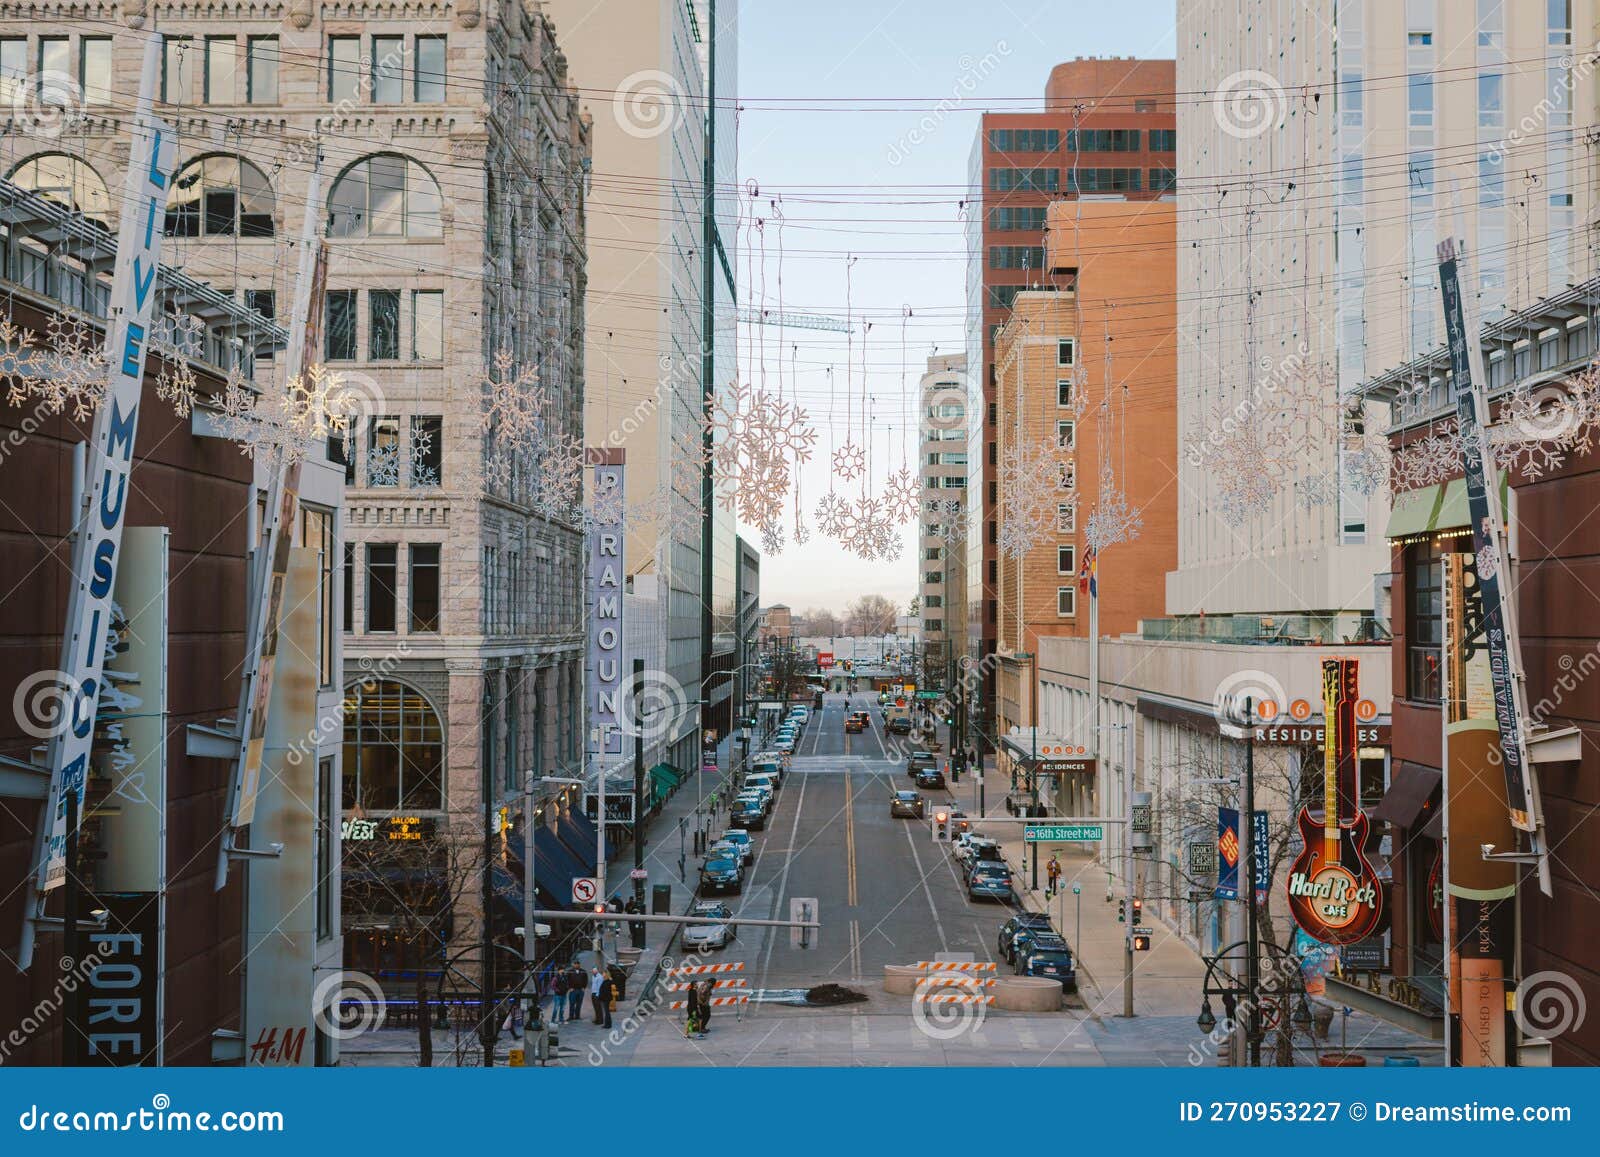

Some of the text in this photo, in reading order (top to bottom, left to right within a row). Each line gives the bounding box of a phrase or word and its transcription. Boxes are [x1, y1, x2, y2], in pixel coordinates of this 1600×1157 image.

[122, 131, 166, 379] LIVE
[72, 397, 138, 739] MUSIC
[1256, 729, 1378, 741] RESIDEES
[391, 816, 420, 824] SALOON
[1036, 828, 1101, 839] 16th Street Mall
[1254, 816, 1263, 884] UPPER
[1289, 872, 1376, 909] Hard Rock
[1322, 904, 1347, 917] CAFE
[88, 932, 143, 1067] FORE
[1480, 1006, 1490, 1036] USED
[251, 1027, 307, 1064] H&M
